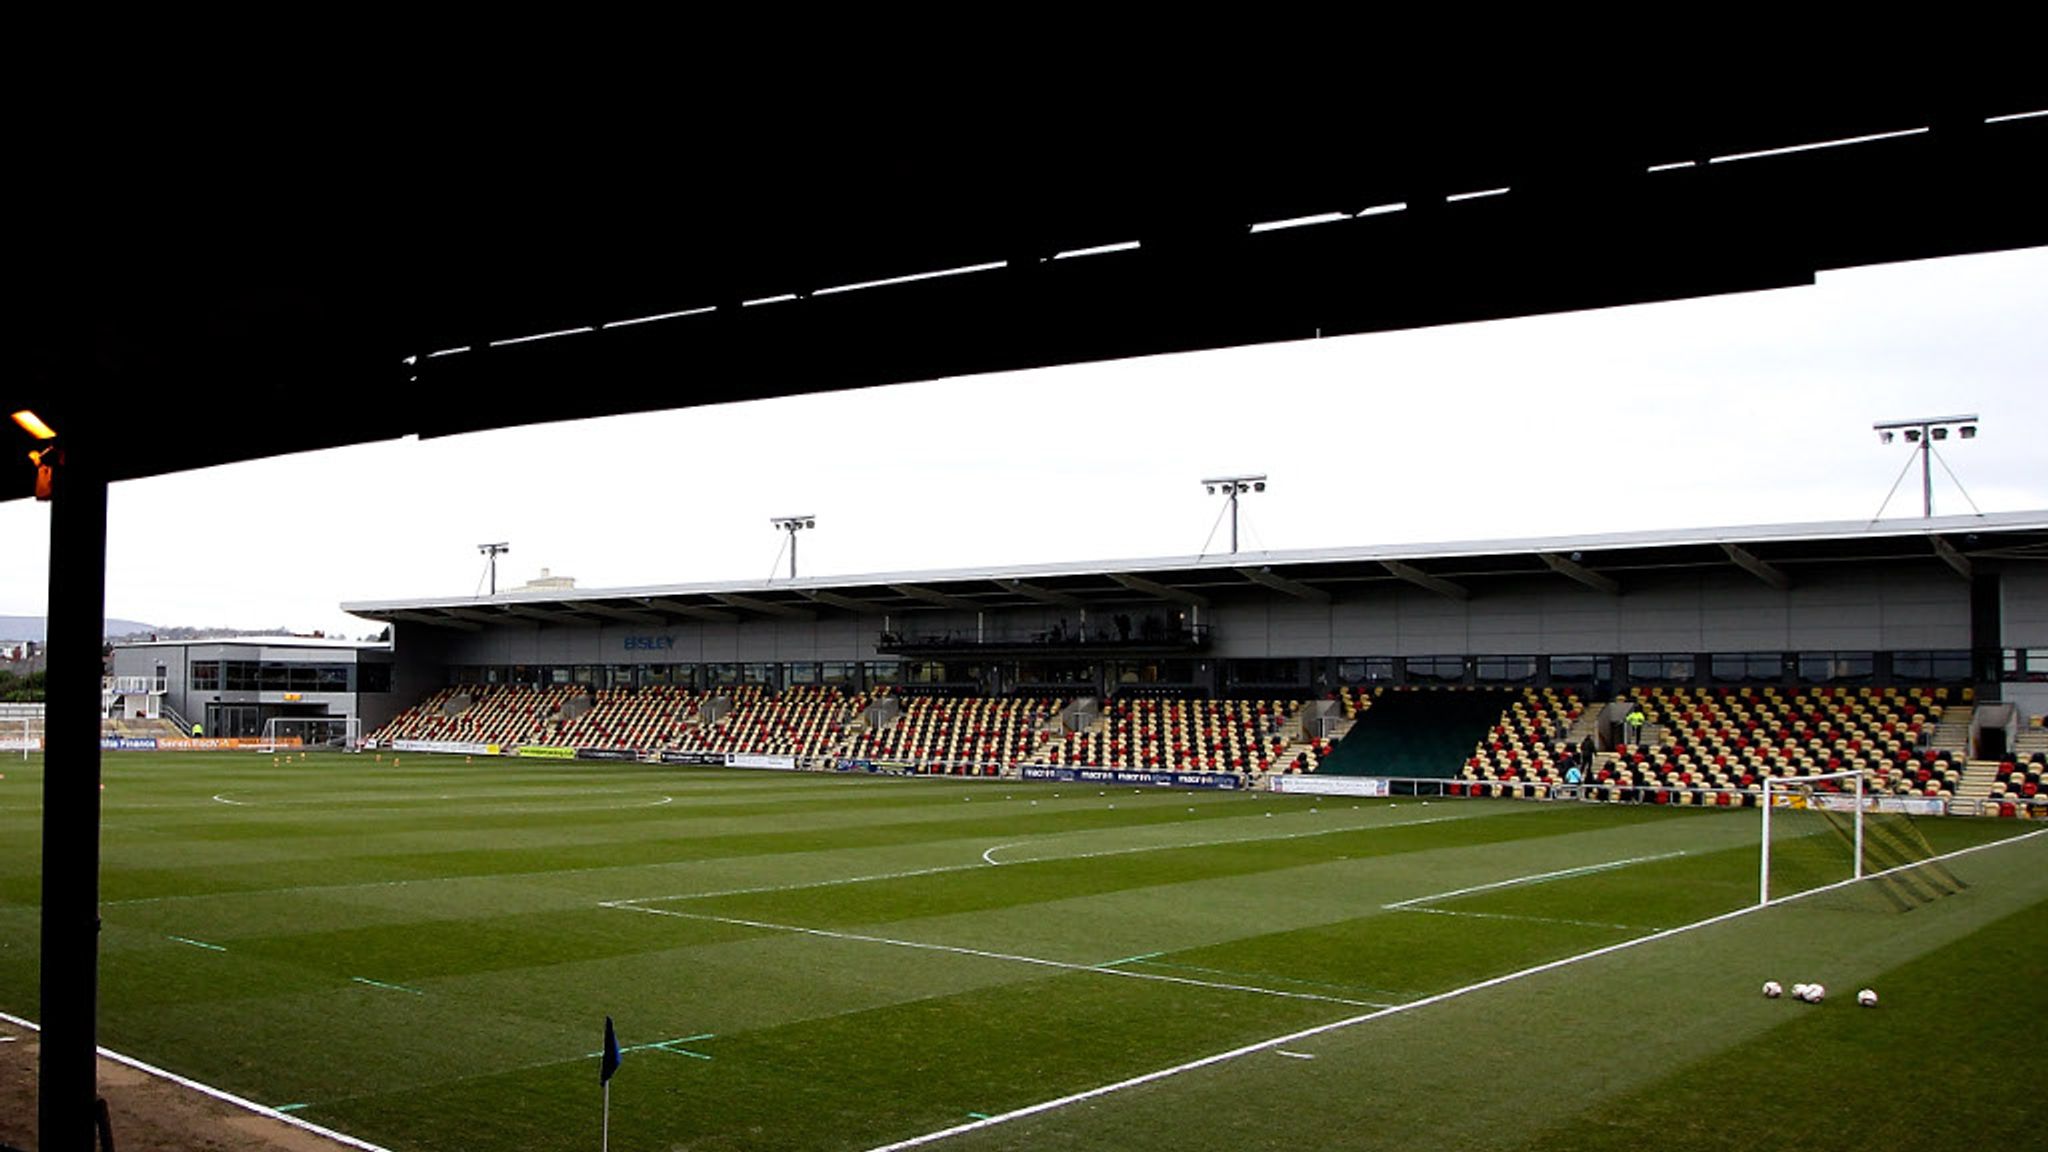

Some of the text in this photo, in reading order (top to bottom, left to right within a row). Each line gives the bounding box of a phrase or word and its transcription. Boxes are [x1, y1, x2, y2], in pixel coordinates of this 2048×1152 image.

[624, 636, 674, 650] BISLEY
[120, 739, 155, 747] Finance
[1024, 769, 1055, 777] macron
[1081, 771, 1113, 780] macron
[1118, 773, 1151, 781] macron
[1178, 775, 1213, 783] macron
